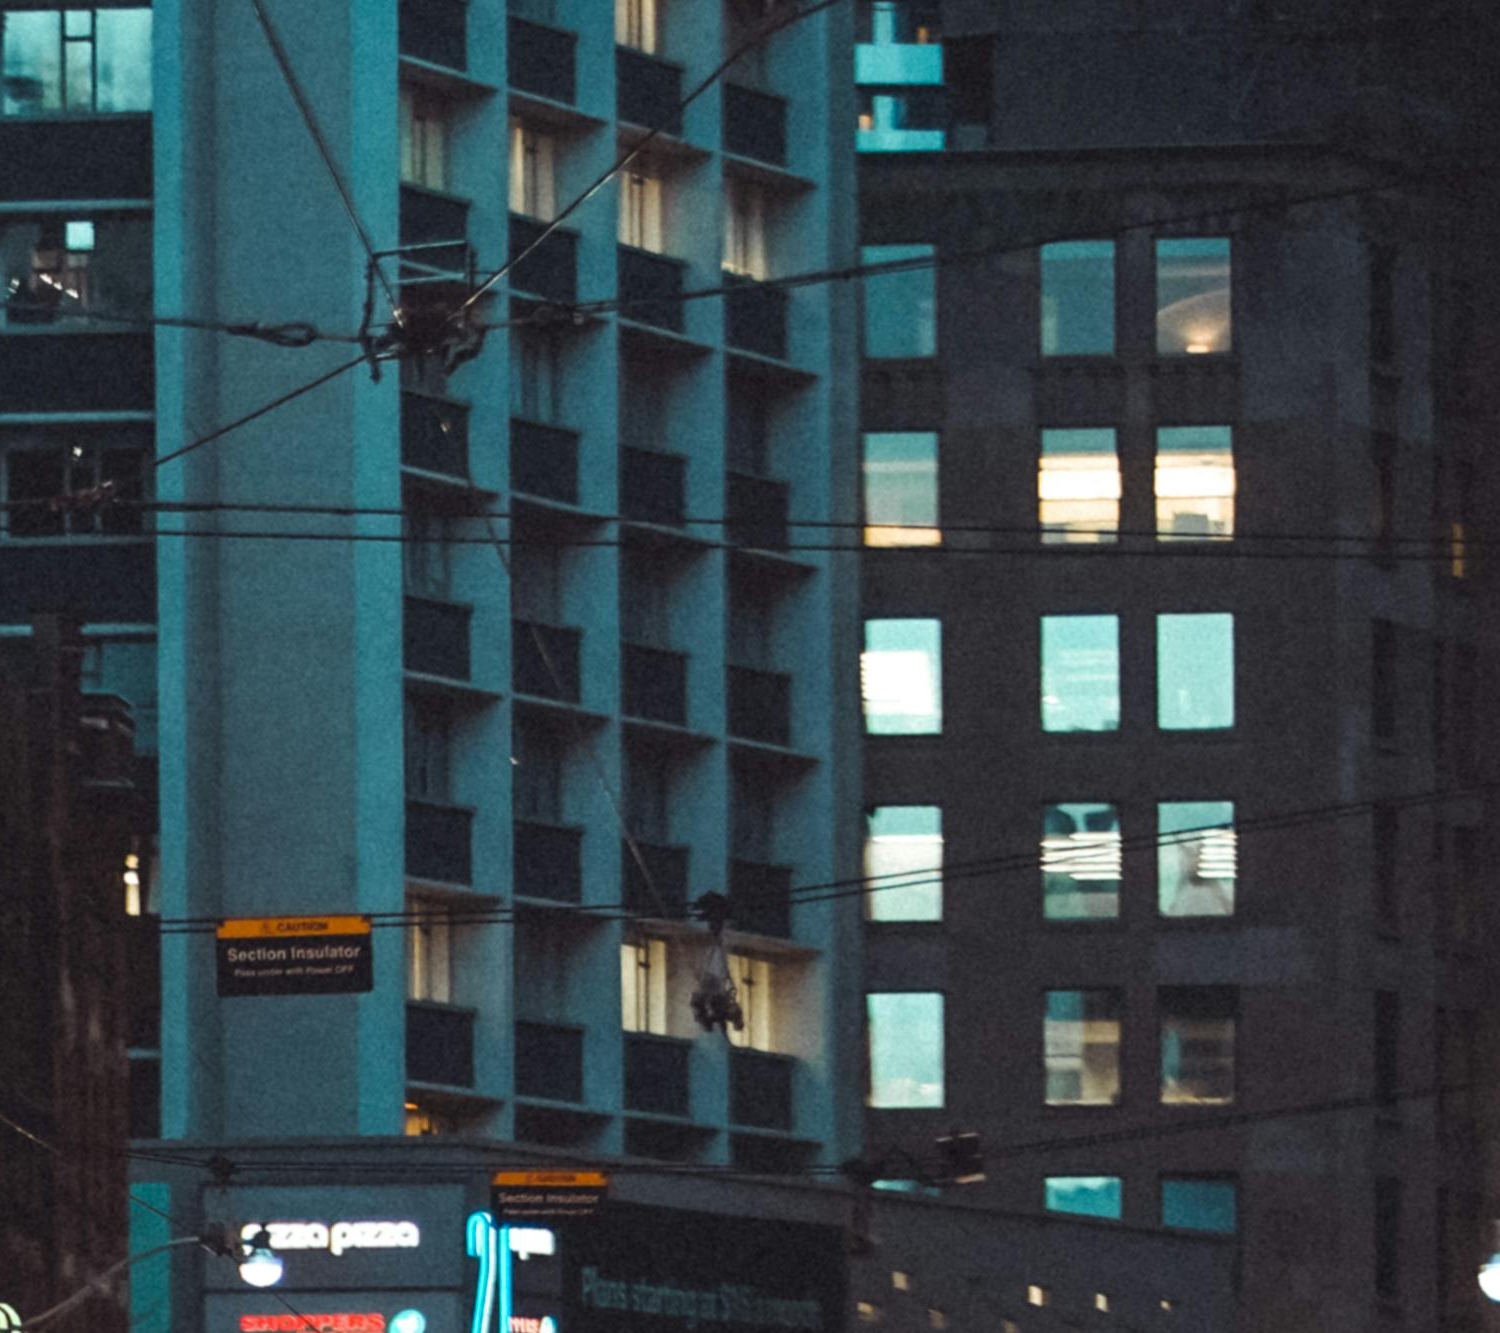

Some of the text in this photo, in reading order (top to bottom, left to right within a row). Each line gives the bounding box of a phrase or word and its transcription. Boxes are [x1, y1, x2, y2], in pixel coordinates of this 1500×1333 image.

[227, 945, 361, 962] Section Insulator
[240, 1222, 329, 1256] pzza
